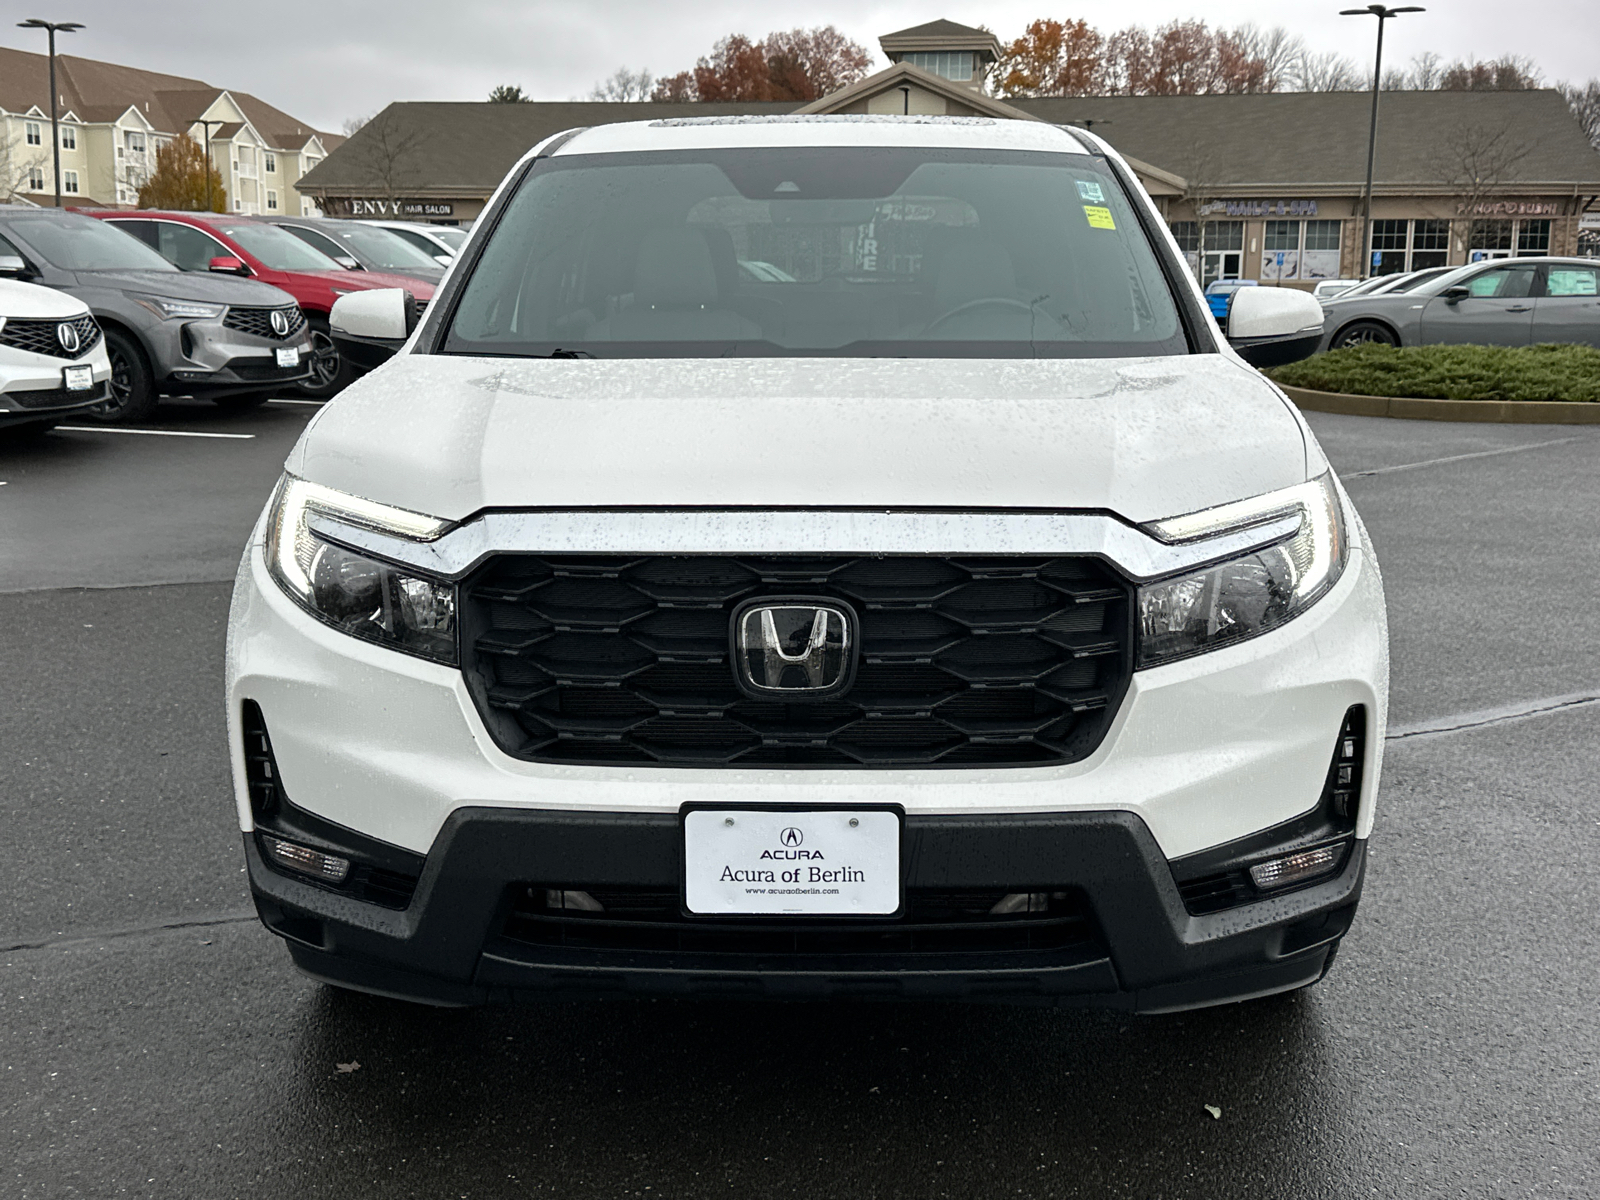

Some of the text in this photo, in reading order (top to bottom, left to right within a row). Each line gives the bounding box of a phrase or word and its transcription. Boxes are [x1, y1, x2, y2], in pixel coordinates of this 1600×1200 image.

[352, 200, 451, 215] ENVY HAIR SALON
[1226, 200, 1270, 216] NAILS
[1275, 200, 1286, 216] &
[1290, 200, 1318, 216] SPA
[1517, 202, 1558, 214] SUSHI
[759, 850, 825, 860] ACURA
[719, 866, 866, 883] Acura of Berlin
[745, 887, 840, 895] www.acuraofberlin.com
